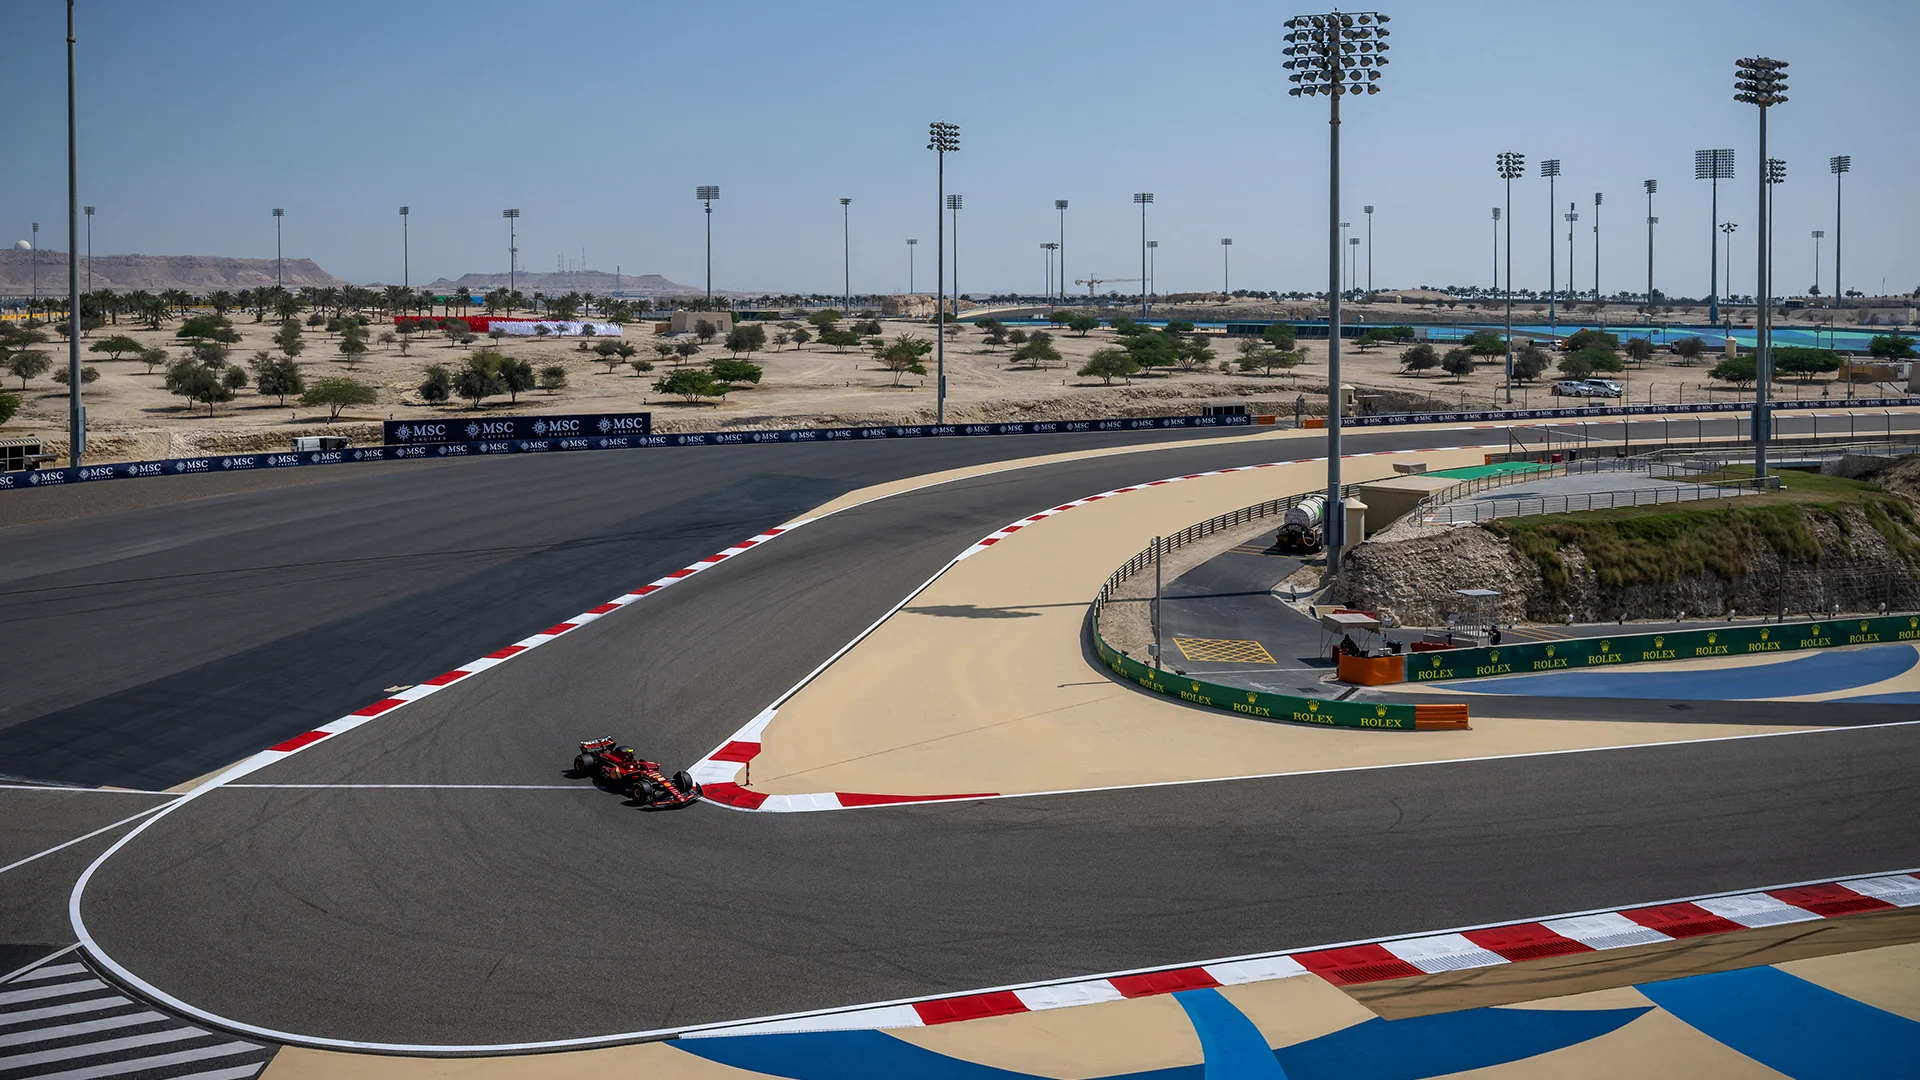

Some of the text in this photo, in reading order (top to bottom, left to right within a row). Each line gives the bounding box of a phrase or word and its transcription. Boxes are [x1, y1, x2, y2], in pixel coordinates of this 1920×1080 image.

[482, 422, 514, 434] MSC
[550, 420, 579, 431] MSC
[614, 418, 643, 429] MSC
[414, 425, 445, 436] MSC
[322, 452, 341, 460] MSC
[406, 447, 425, 455] MSC
[140, 464, 161, 472] MSC
[187, 460, 208, 468] MSC
[41, 472, 64, 481] MSC
[91, 467, 113, 476] MSC
[0, 476, 13, 485] SC
[1850, 634, 1880, 643] ROLEX
[1899, 630, 1920, 639] ROLE
[1749, 642, 1780, 651] ROLEX
[1801, 637, 1831, 647] ROLEX
[1643, 650, 1675, 660] ROLEX
[1696, 645, 1728, 656] ROLEX
[1588, 654, 1621, 664] ROLEX
[1477, 664, 1511, 675] ROLEX
[1533, 659, 1567, 670] ROLEX
[1418, 669, 1454, 679] ROLEX
[1140, 678, 1164, 693] ROLEX
[1181, 690, 1211, 705] ROLEX
[1233, 703, 1270, 716] ROLEX
[1294, 712, 1334, 724] ROLEX
[1361, 718, 1402, 727] ROLEX
